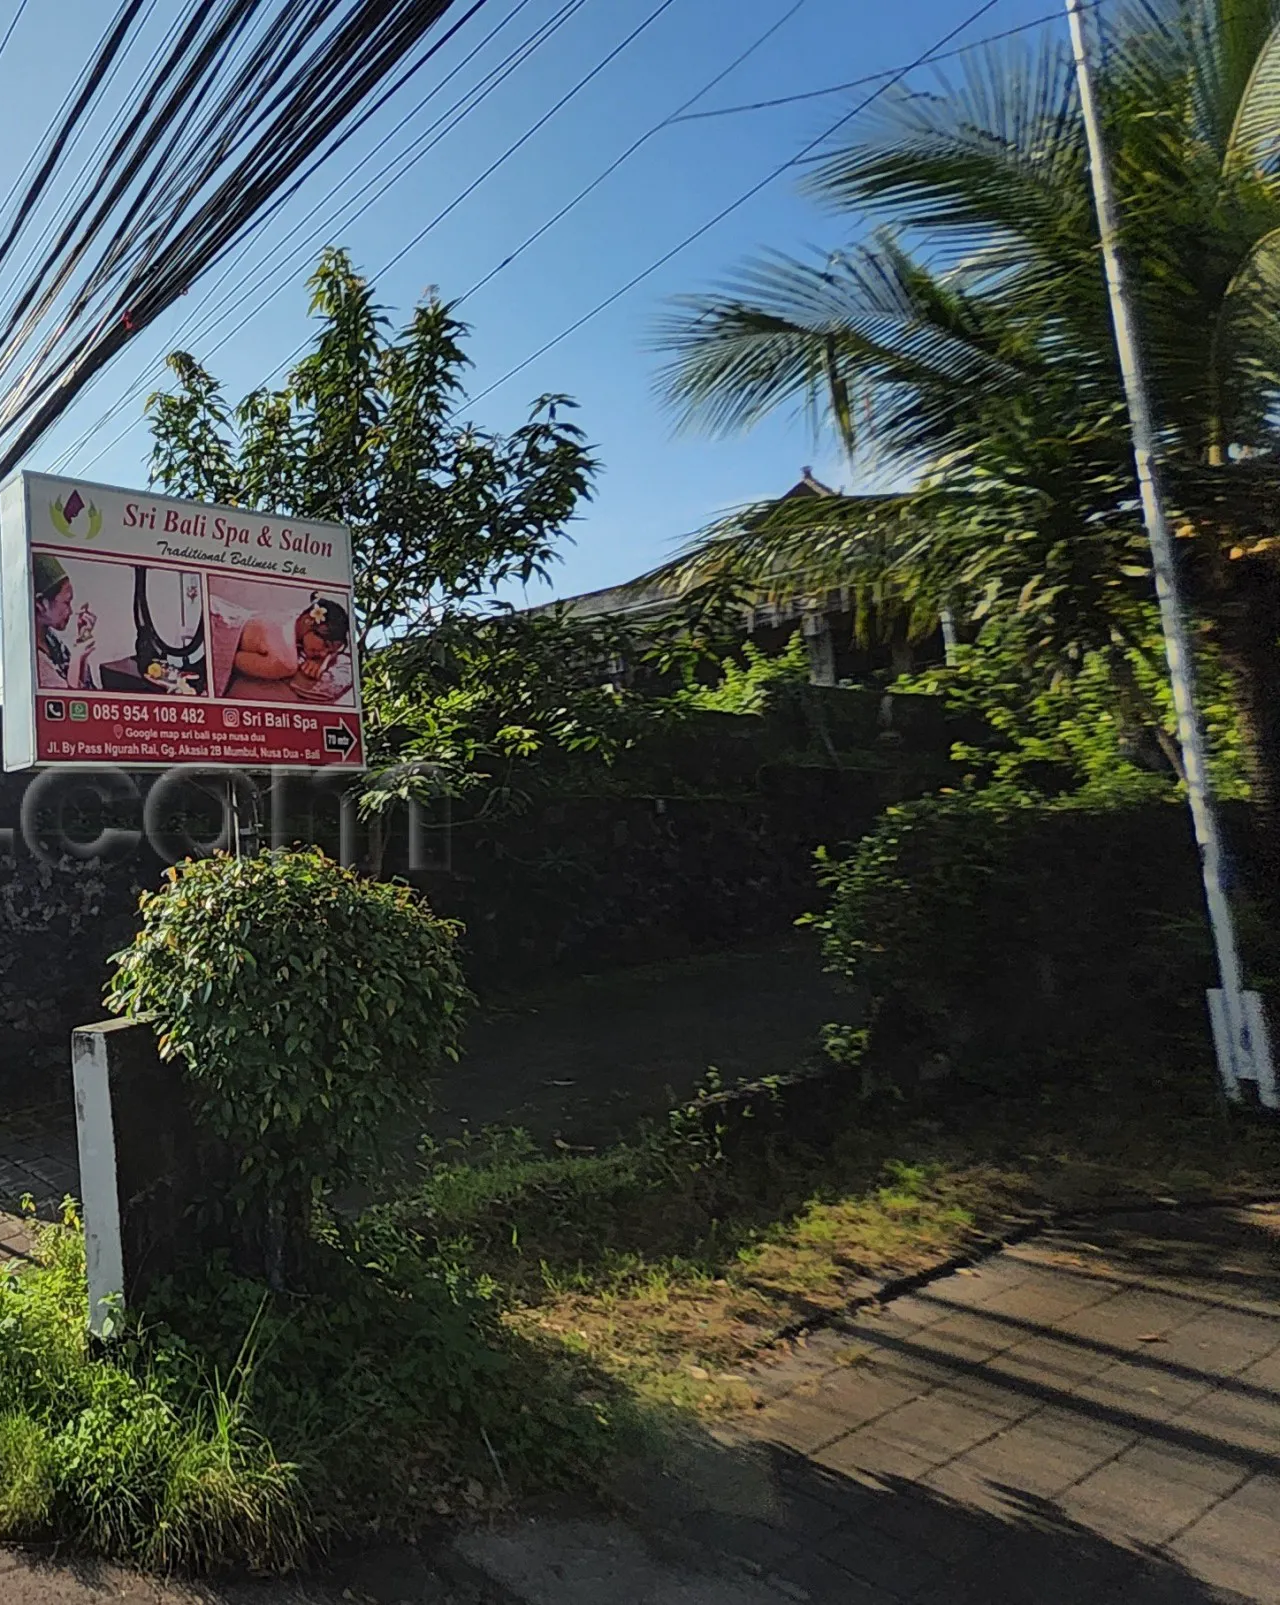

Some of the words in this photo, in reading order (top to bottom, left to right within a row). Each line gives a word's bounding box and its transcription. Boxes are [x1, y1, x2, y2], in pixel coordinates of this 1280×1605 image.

[123, 503, 156, 530] Sri
[164, 510, 207, 538] Bali
[212, 517, 249, 547] Spa
[257, 525, 273, 548] &
[279, 528, 333, 558] Salon
[156, 541, 226, 563] Traditional
[230, 551, 278, 571] Balinese
[282, 561, 307, 576] Spa
[92, 704, 120, 720] 085
[123, 705, 149, 722] 954
[153, 706, 177, 723] 108
[180, 708, 205, 724] 482
[242, 711, 261, 727] Sri
[265, 712, 291, 728] Bali
[293, 714, 318, 733] Spa
[125, 727, 158, 741] Google
[159, 730, 179, 741] map
[194, 731, 210, 740] bali
[212, 733, 227, 743] spa
[229, 733, 249, 742] nusa
[250, 733, 266, 742] dua
[62, 742, 76, 756] By
[78, 743, 102, 755] Pass
[104, 742, 140, 756] Ngurah
[160, 744, 176, 757] Gg.
[178, 744, 209, 756] Akasia
[260, 747, 282, 759] Nusa
[283, 748, 299, 759] Dua
[305, 749, 321, 760] Bali
